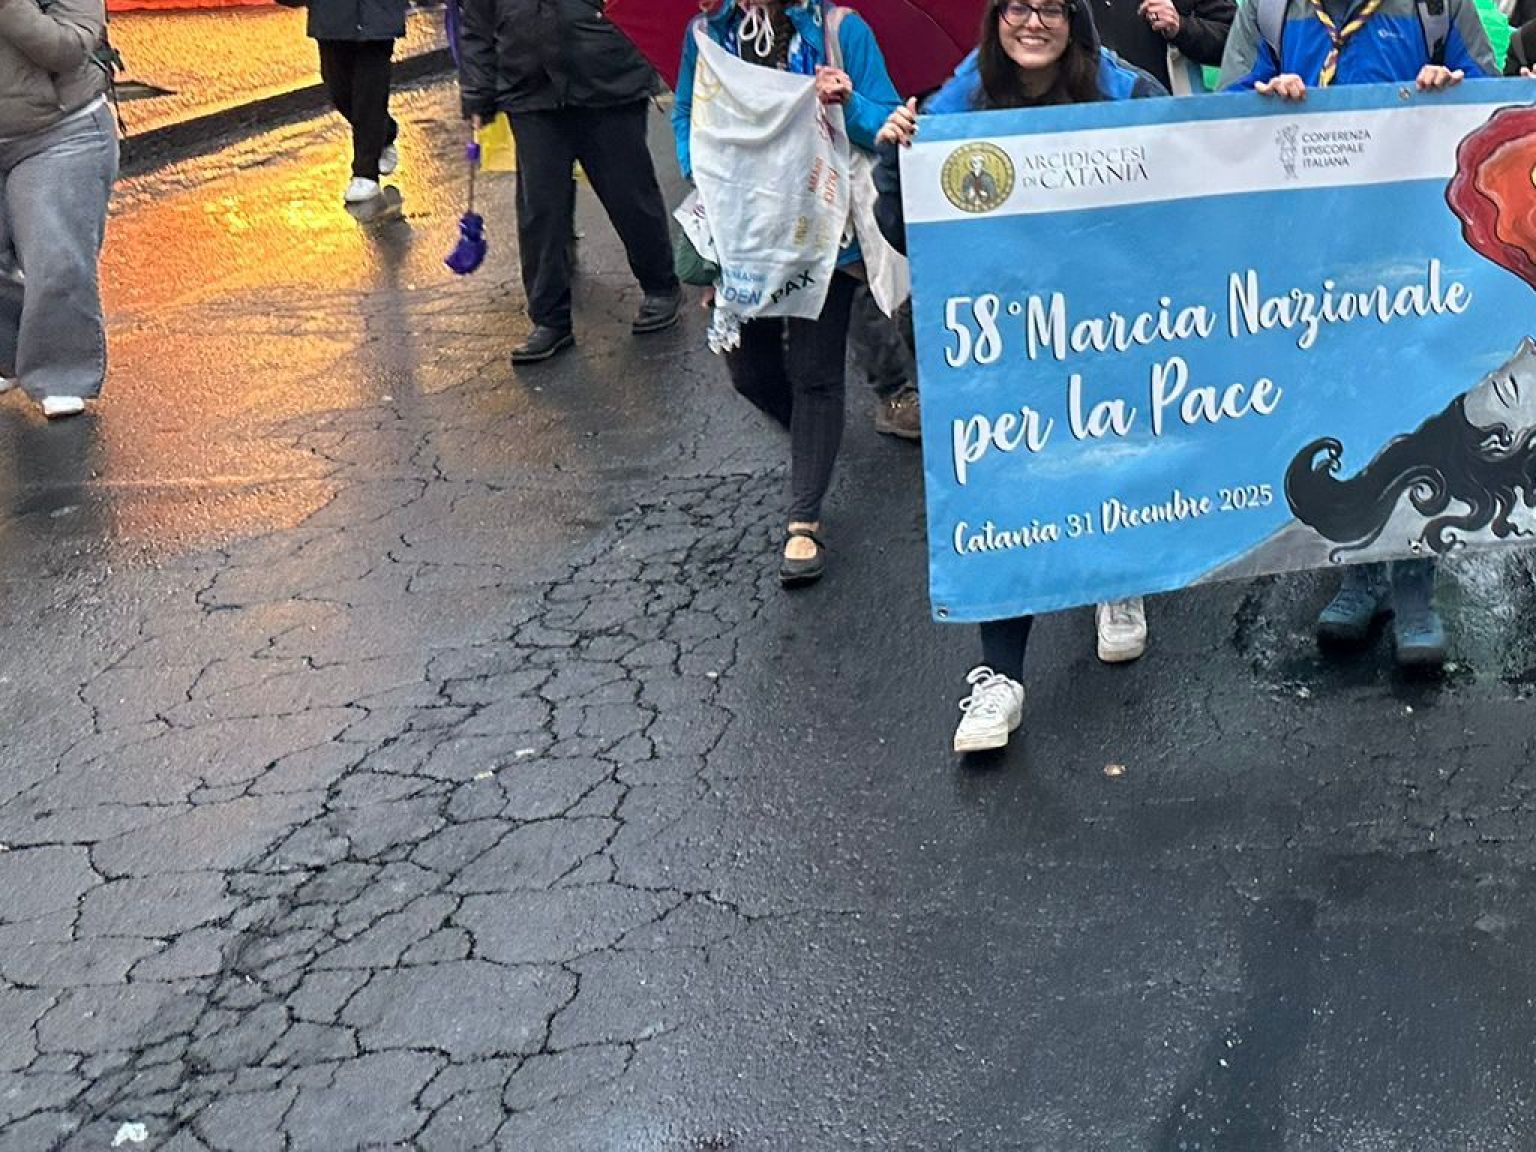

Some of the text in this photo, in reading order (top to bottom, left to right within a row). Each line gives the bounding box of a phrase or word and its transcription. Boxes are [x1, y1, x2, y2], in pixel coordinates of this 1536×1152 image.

[1301, 128, 1372, 143] CONFERENZA
[1301, 142, 1364, 156] EPISCOPALE
[1022, 144, 1147, 170] ARCIDIOCESI
[1302, 155, 1350, 168] ITALIANA
[1039, 162, 1149, 190] CATANIA
[770, 269, 816, 304] PAX
[1026, 292, 1216, 362] Marcia
[1228, 258, 1473, 350] Nazionale
[952, 355, 1284, 484] per la Pace
[954, 483, 1274, 556] Catania 31 Dicembre 2025
